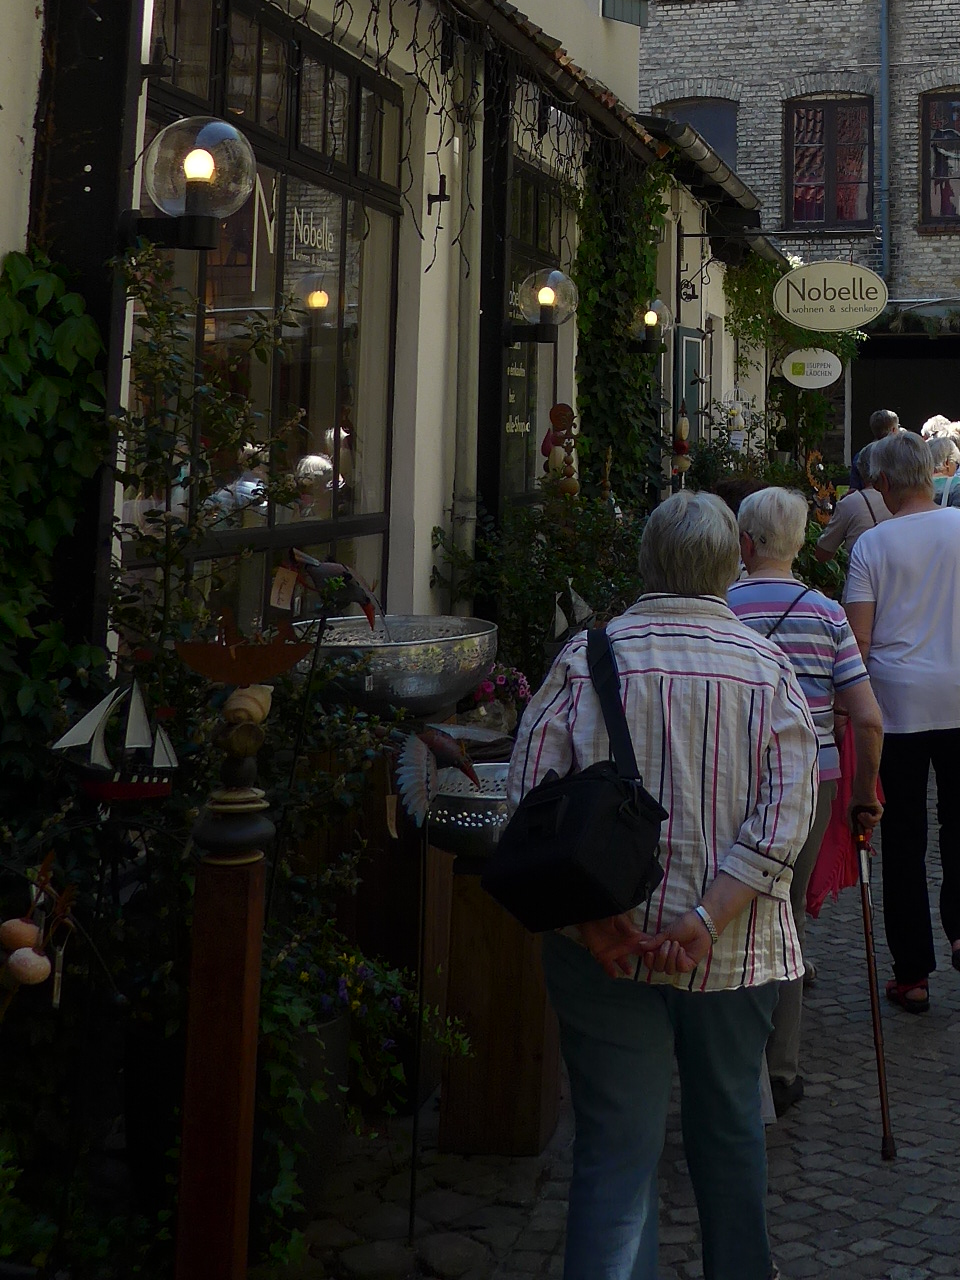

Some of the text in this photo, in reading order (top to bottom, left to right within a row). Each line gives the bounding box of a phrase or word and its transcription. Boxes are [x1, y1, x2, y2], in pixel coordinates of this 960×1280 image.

[292, 206, 334, 260] Nobelle
[786, 277, 879, 314] Nobelle
[792, 304, 879, 313] wohnen & schenken
[805, 369, 833, 377] LÄDCHEN
